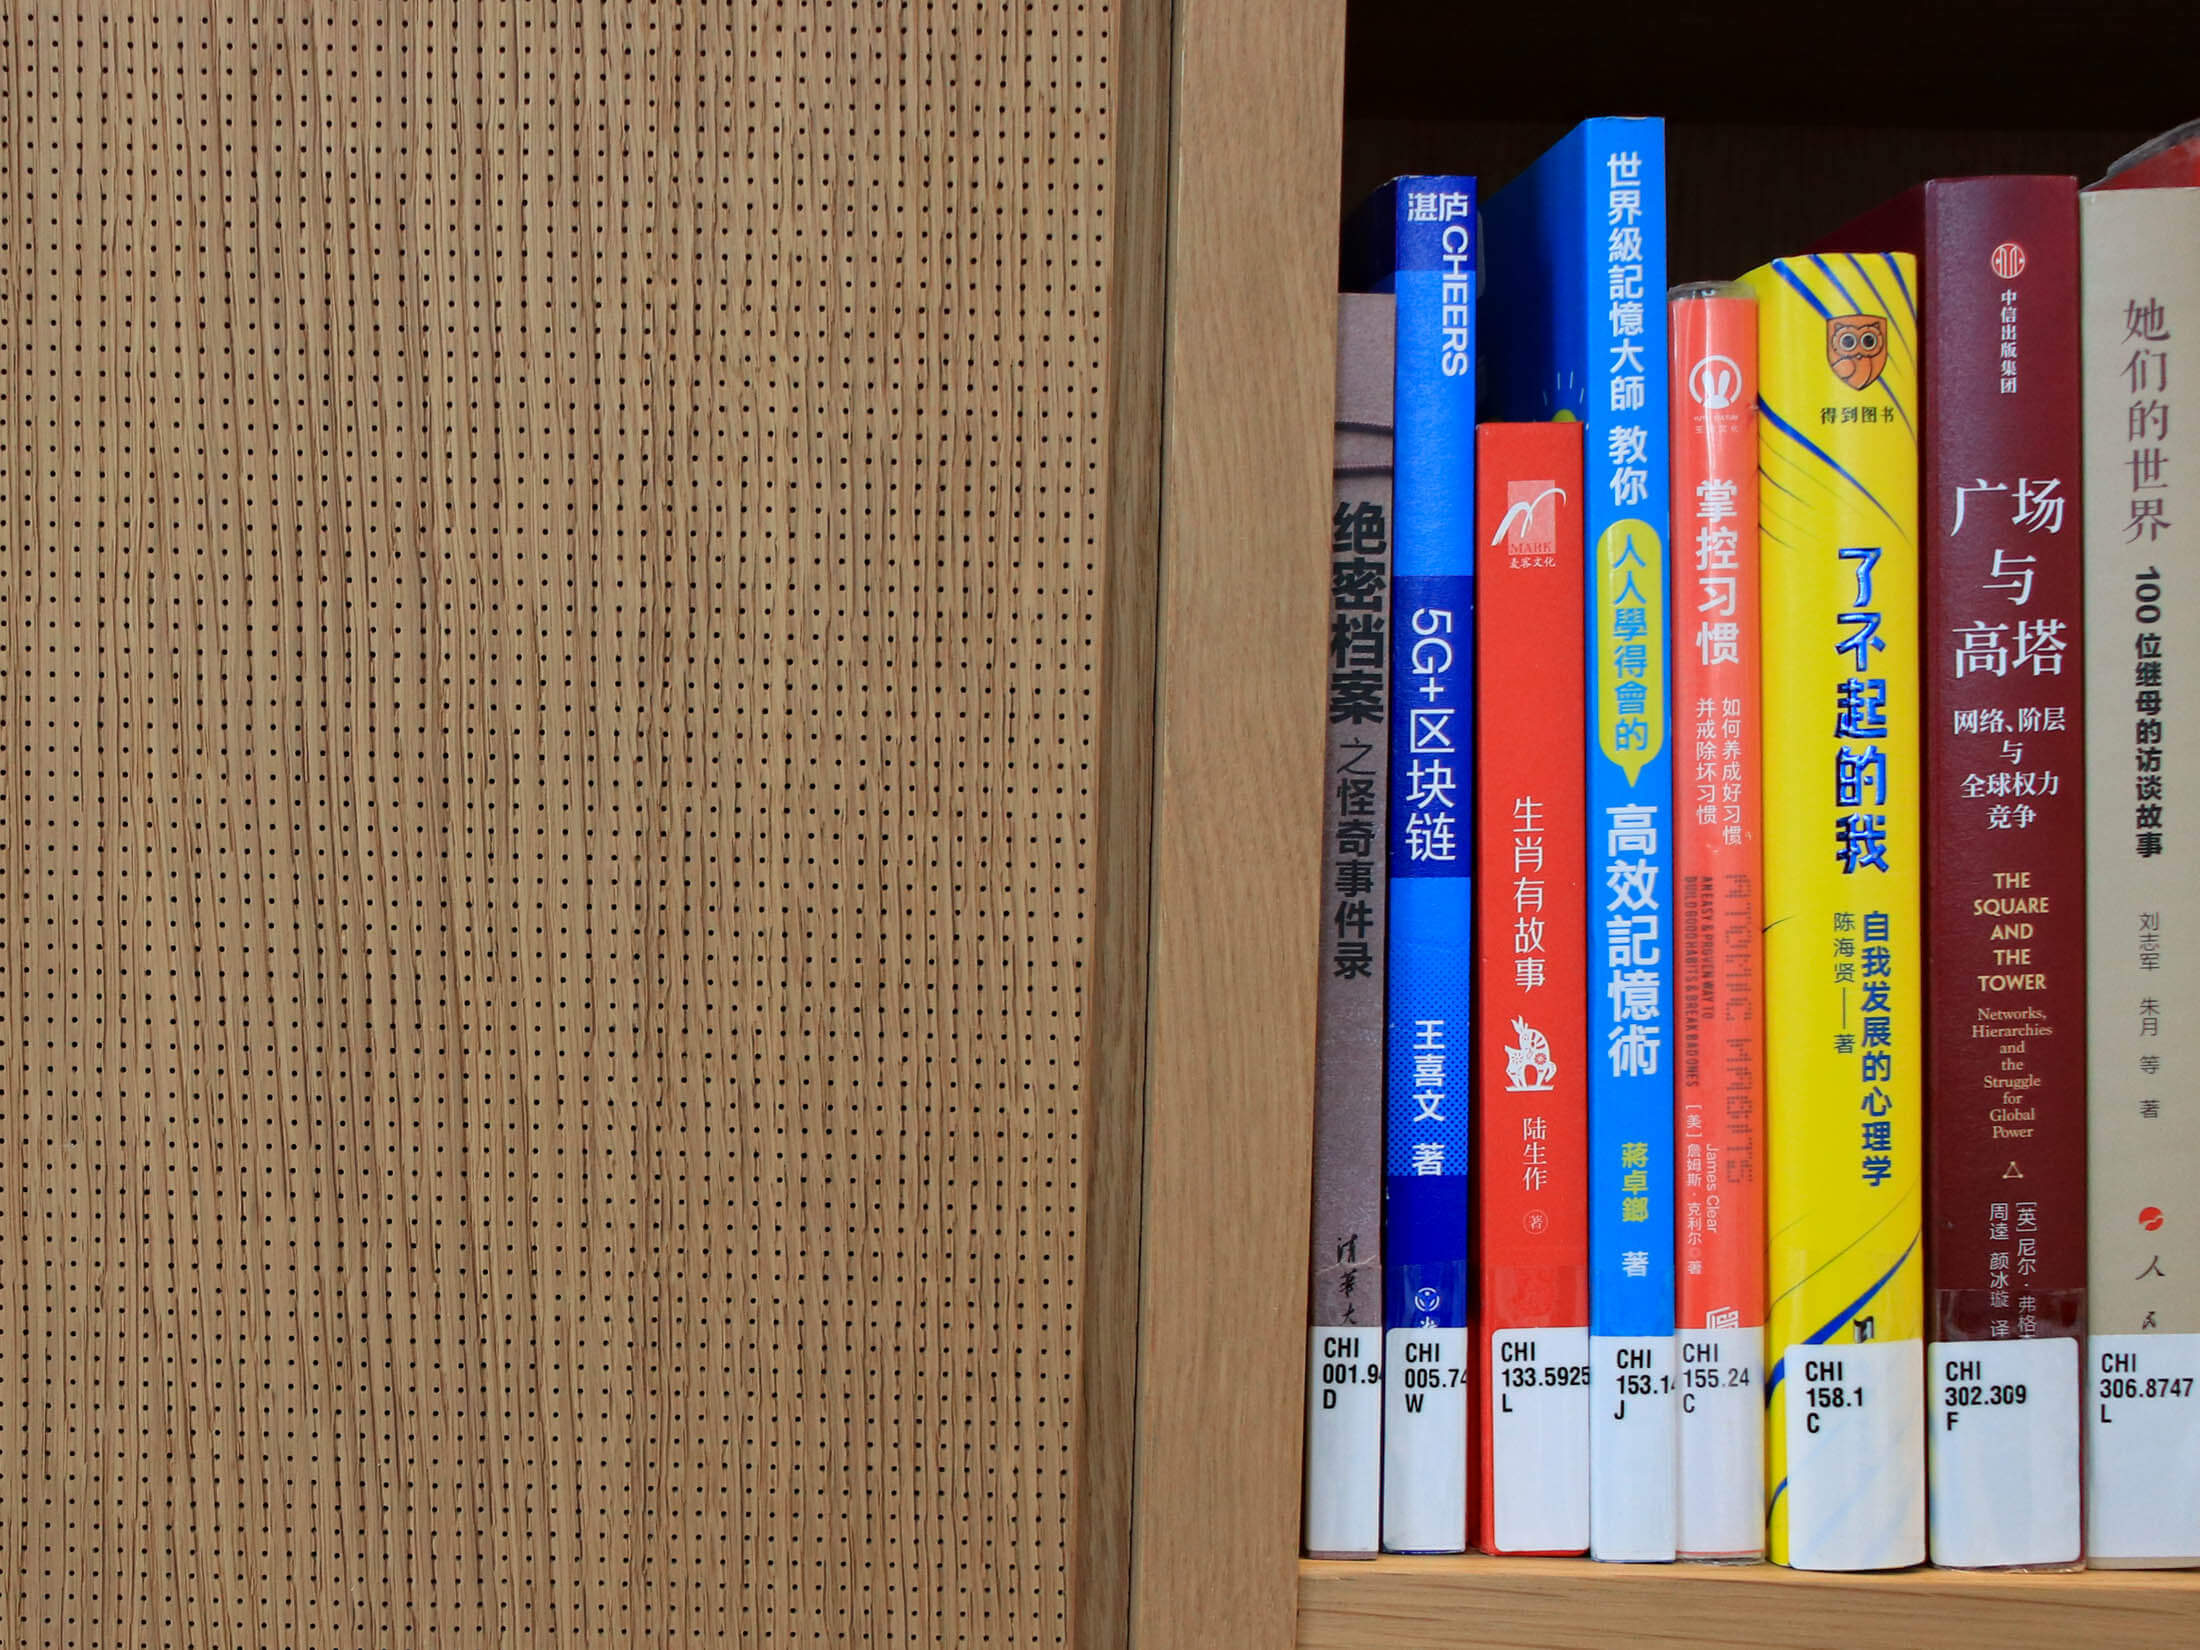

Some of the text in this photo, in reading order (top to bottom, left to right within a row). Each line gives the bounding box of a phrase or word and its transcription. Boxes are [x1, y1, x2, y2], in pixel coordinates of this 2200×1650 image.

[1408, 192, 1468, 222] 湛庐
[1441, 225, 1468, 377] CHEERS
[1607, 151, 1648, 506] 世界級記憶大師 教你
[2000, 289, 2017, 394] 中信出版集团
[1821, 407, 1894, 424] 得到图书
[2120, 297, 2171, 544] 她们的世界
[1951, 478, 2065, 536] 广场
[1696, 479, 1740, 665] 掌控习惯
[1982, 549, 2036, 605] 与
[1330, 502, 1387, 724] 绝密档案
[1613, 534, 1648, 751] 人人學得會的
[1952, 619, 2067, 678] 高塔
[1834, 547, 1889, 874] 了不起的我
[1953, 707, 2066, 735] 网络、阶层
[1405, 608, 1456, 861] 5G+区块链
[1696, 698, 1717, 825] 并戒除坏习惯
[2000, 740, 2023, 765] 与
[1722, 697, 1742, 846] 如何养成好习惯
[1960, 771, 2059, 798] 全球权力
[1986, 804, 2036, 830] 竞争
[1334, 737, 1376, 979] 之怪奇事件录
[1992, 872, 2031, 889] THE
[1513, 796, 1545, 992] 生肖有故事
[1973, 897, 2049, 916] SQUARE
[1606, 803, 1660, 1077] 高效記憶術
[1990, 923, 2033, 940] AND
[1994, 949, 2031, 966] THE
[1701, 981, 1714, 1002] WAY
[1833, 912, 1856, 1054] 陈海贤 著
[1978, 974, 2046, 992] TOWER
[1701, 1006, 1714, 1019] TO
[1977, 1007, 2047, 1021] Networks,
[2139, 912, 2160, 1119] 刘志军 朱月 等 著
[1972, 1024, 2053, 1039] Hierarchies
[1861, 911, 1892, 1187] 自我发展的心理学
[1999, 1041, 2025, 1055] and
[2001, 1058, 2023, 1072] the
[1984, 1075, 2041, 1090] Struggle
[1412, 1020, 1446, 1176] 王喜文 著
[2003, 1092, 2022, 1105] for
[1989, 1108, 2035, 1122] Global
[1992, 1126, 2034, 1139] Power
[1522, 1116, 1548, 1191] 陆生作
[1706, 1144, 1720, 1232] James Clear
[1622, 1251, 1648, 1278] 著
[1324, 1338, 1359, 1358] CHI
[1406, 1343, 1440, 1362] CHI
[1501, 1342, 1535, 1361] CHI
[1682, 1343, 1719, 1363] CHI
[1617, 1349, 1651, 1369] CHI
[2101, 1353, 2136, 1372] CHI
[1323, 1364, 1382, 1384] 001.9
[1502, 1366, 1591, 1387] 133.5925
[1683, 1368, 1749, 1389] 155.24
[1805, 1361, 1843, 1382] CHI
[1945, 1361, 1981, 1381] CHI
[1616, 1375, 1675, 1395] 153.1
[1945, 1384, 2027, 1406] 302.309
[2100, 1378, 2194, 1398] 306.8747
[1323, 1389, 1337, 1409] D
[1406, 1394, 1424, 1413] W
[1502, 1394, 1512, 1412] L
[1683, 1394, 1695, 1413] C
[1806, 1387, 1863, 1408] 158.1
[1614, 1400, 1625, 1420] J
[2101, 1404, 2112, 1422] L
[1807, 1413, 1820, 1433] C
[1947, 1412, 1959, 1430] F
